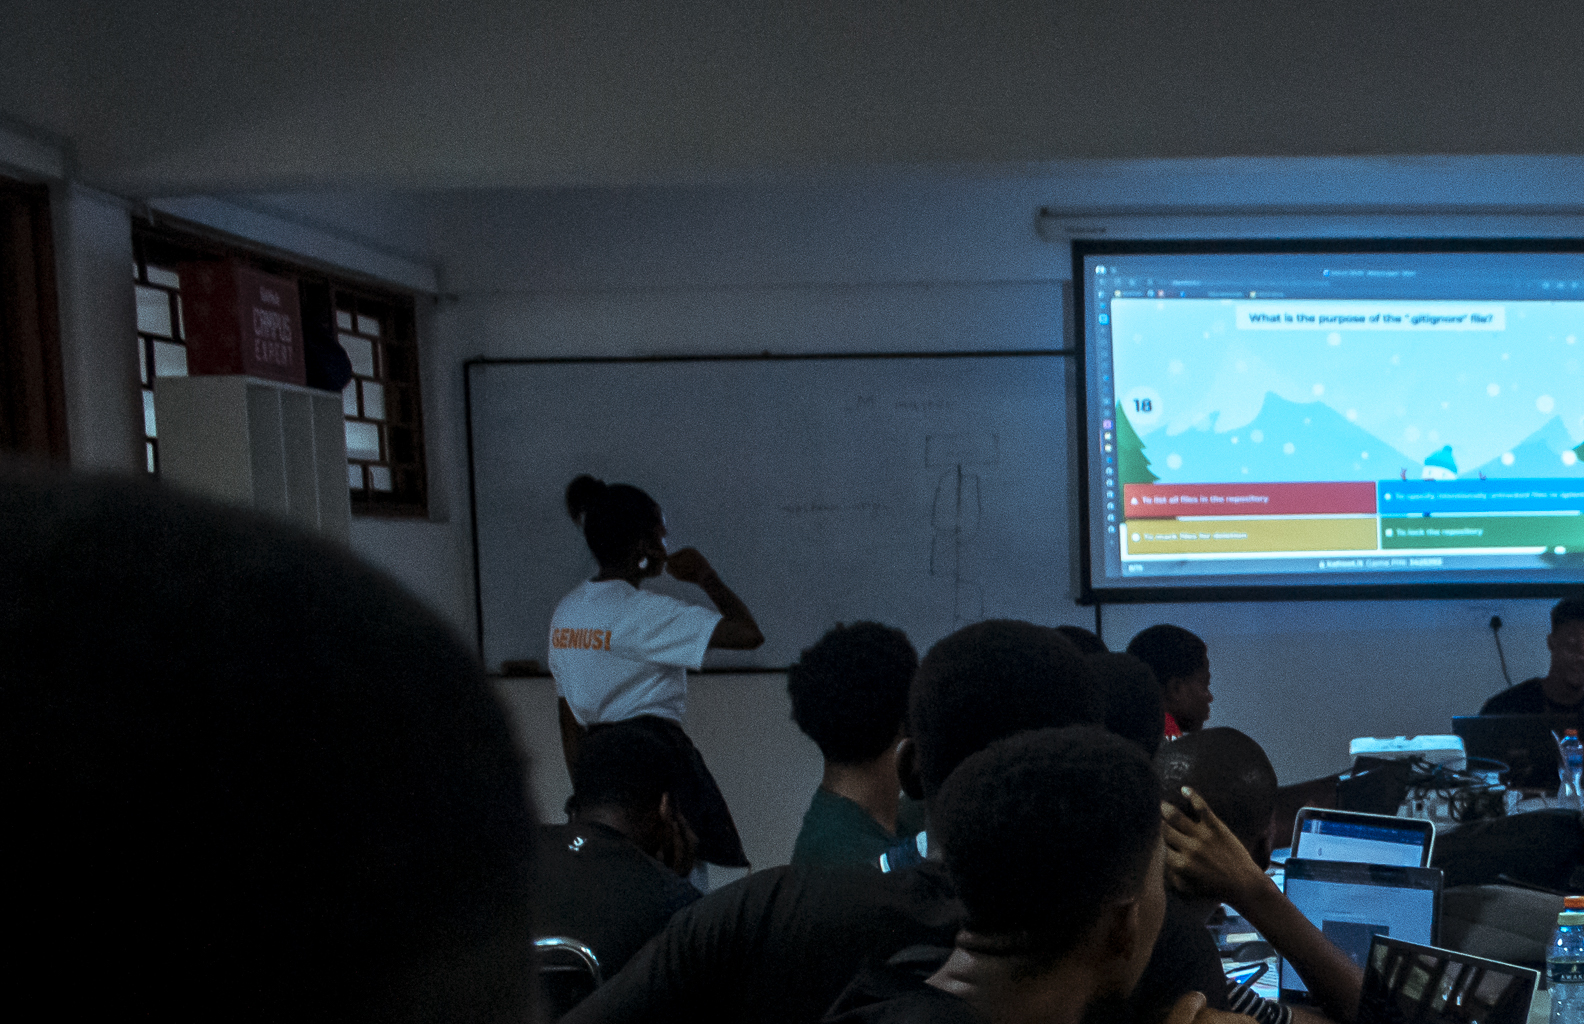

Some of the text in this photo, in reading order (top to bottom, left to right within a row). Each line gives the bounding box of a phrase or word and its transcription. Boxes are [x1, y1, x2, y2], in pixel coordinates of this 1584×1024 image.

[1249, 313, 1281, 323] What
[1284, 313, 1293, 323] is
[1296, 313, 1315, 323] the
[1319, 315, 1366, 325] purpose
[1368, 313, 1381, 323] of
[1383, 313, 1402, 323] the
[1470, 313, 1493, 323] file?
[1133, 398, 1152, 413] 18
[1143, 496, 1153, 504] To
[1154, 496, 1167, 504] list
[1180, 495, 1198, 503] files
[1199, 495, 1208, 503] in
[1210, 495, 1225, 503] the
[1226, 494, 1269, 504] repository
[1179, 532, 1198, 540] files
[1212, 531, 1248, 539] deletion
[1396, 528, 1407, 537] To
[1426, 528, 1441, 536] the
[1441, 527, 1484, 537] repository
[552, 627, 612, 651] GENIUS!
